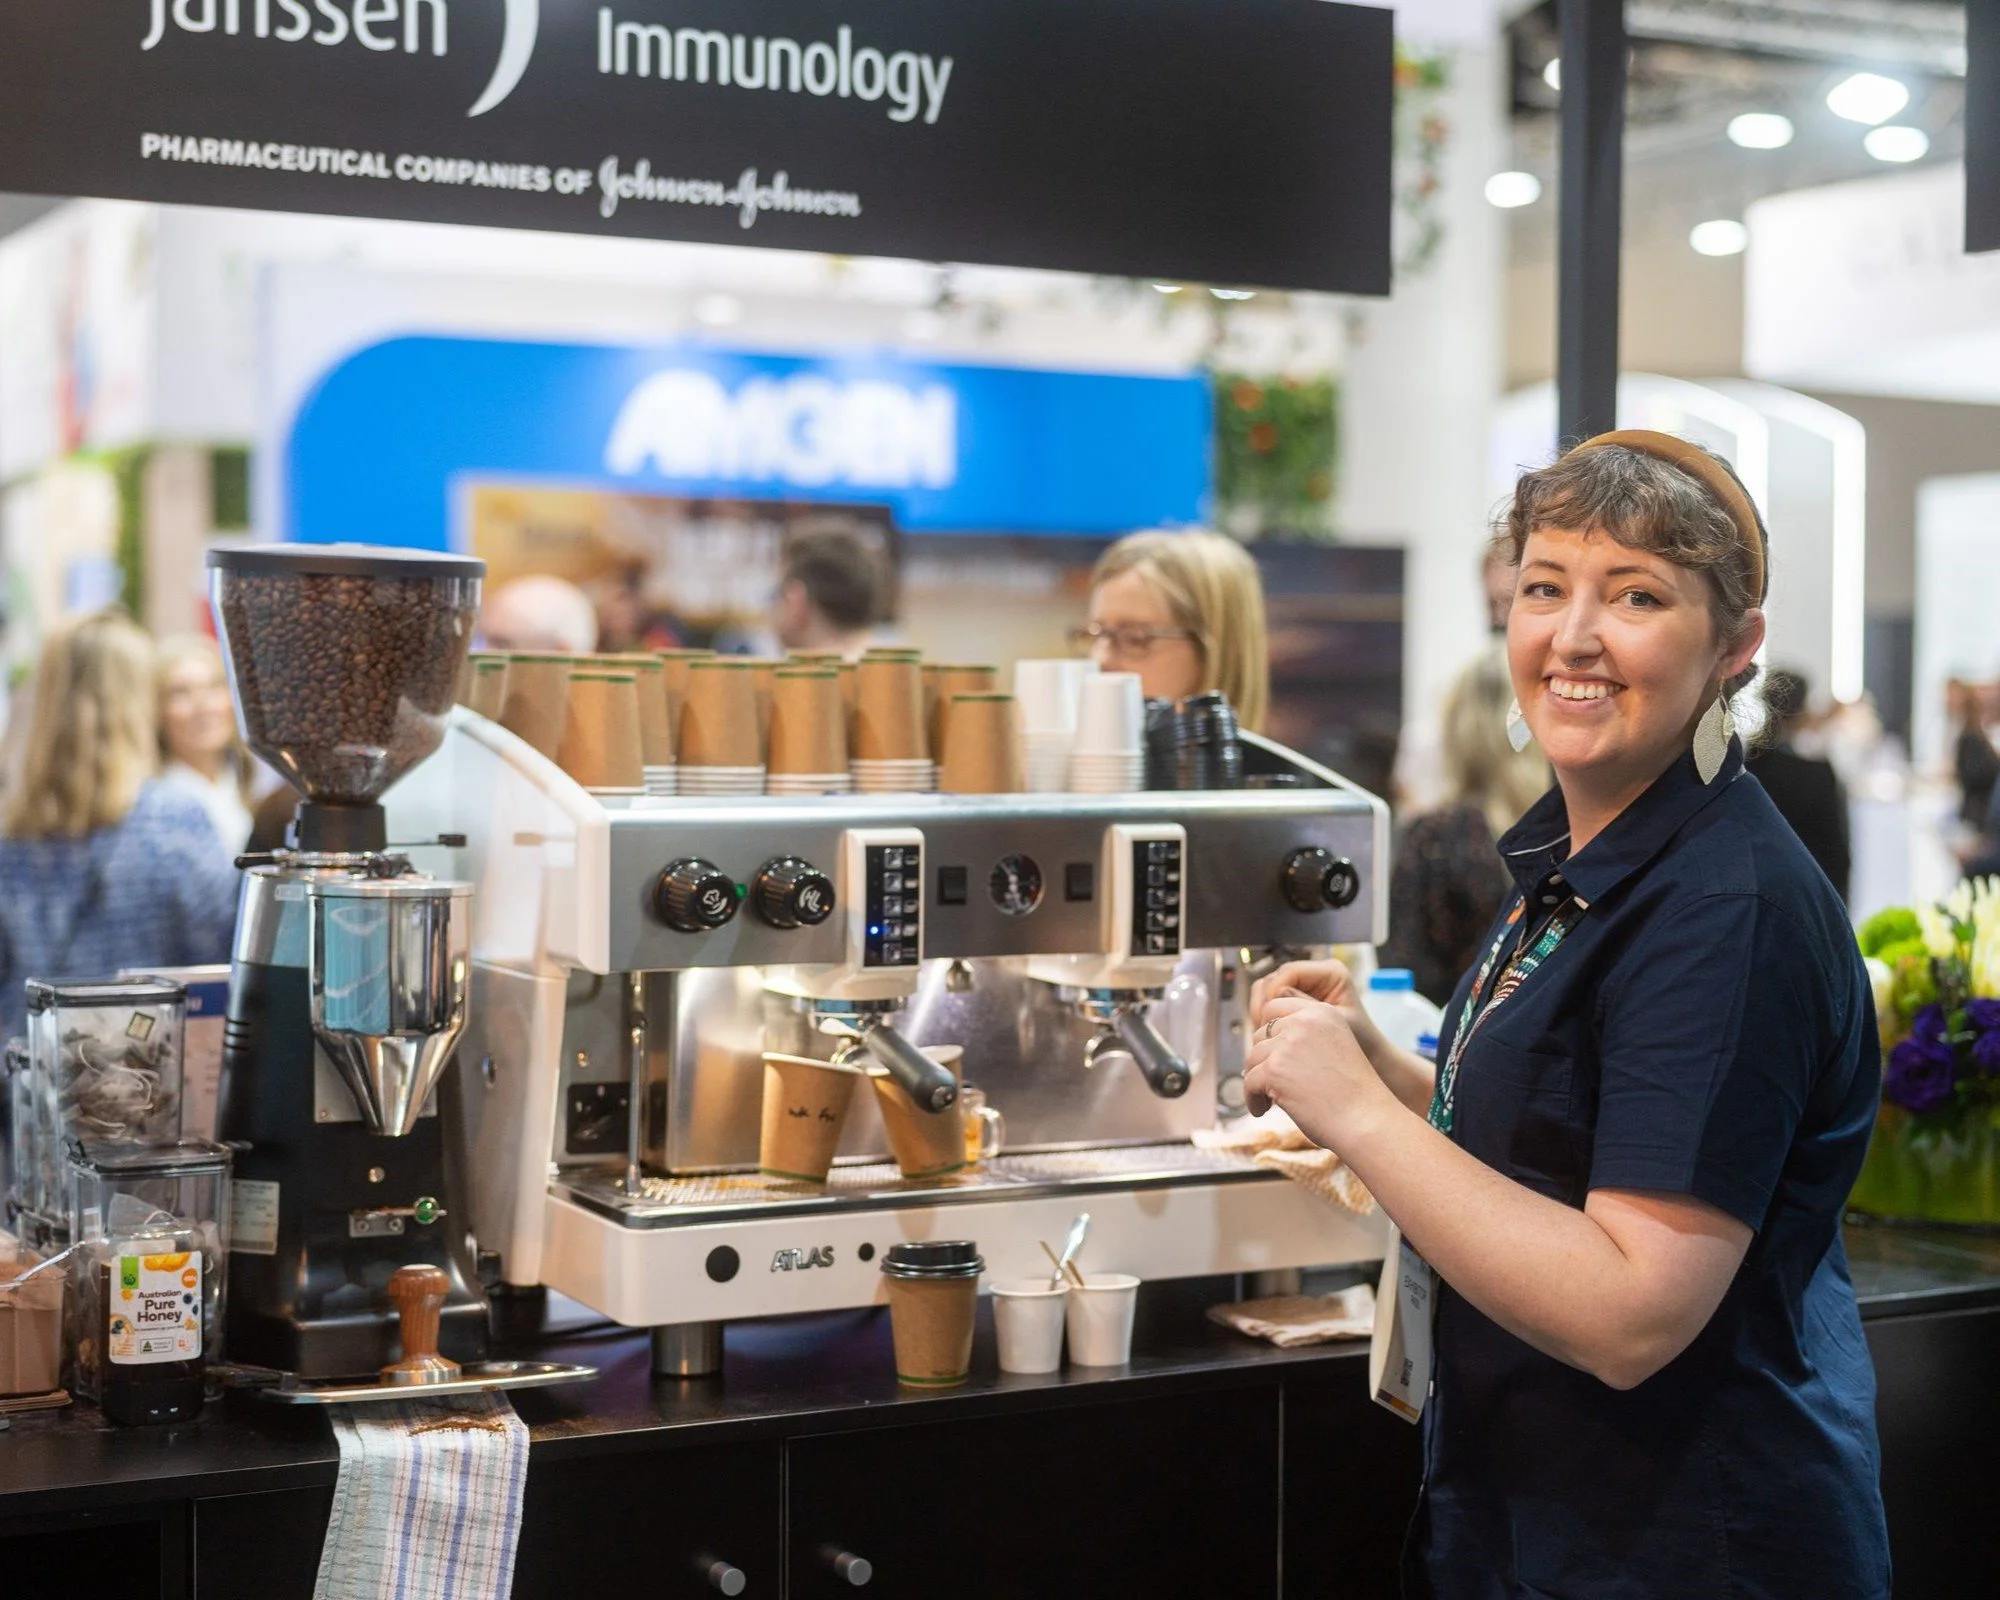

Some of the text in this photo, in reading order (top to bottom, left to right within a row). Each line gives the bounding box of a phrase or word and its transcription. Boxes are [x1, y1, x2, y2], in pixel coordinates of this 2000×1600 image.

[598, 7, 954, 124] Immunology
[140, 132, 392, 180] PHARMACEUTICAL
[394, 153, 551, 193] COMPANIES
[553, 166, 593, 195] OF
[769, 1245, 835, 1273] ATLAS
[138, 1289, 182, 1299] Australian
[144, 1299, 176, 1311] Pure
[137, 1310, 183, 1323] Honey
